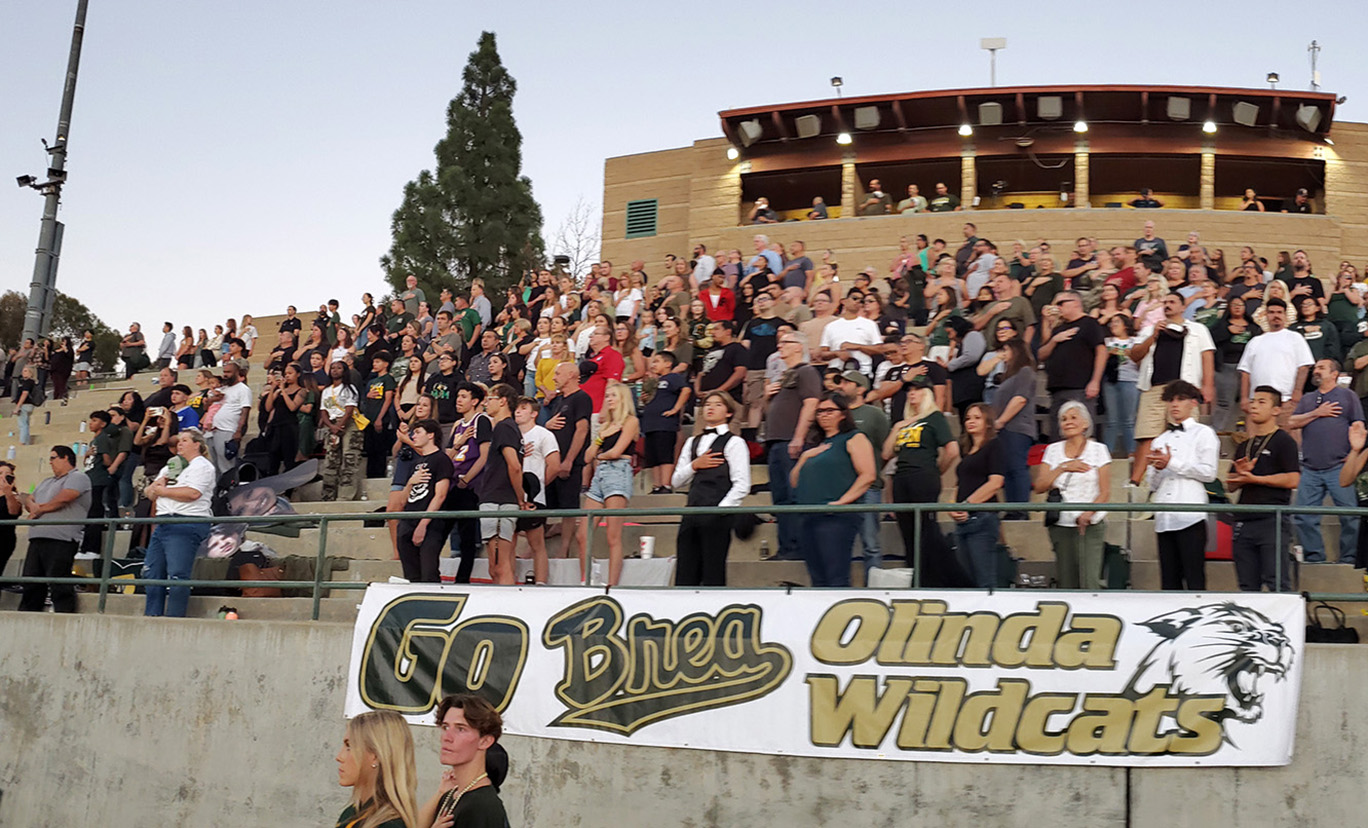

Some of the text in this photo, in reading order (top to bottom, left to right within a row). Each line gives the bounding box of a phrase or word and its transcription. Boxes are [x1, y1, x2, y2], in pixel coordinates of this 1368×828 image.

[542, 597, 793, 736] Brea
[811, 598, 1122, 669] Olinda
[804, 673, 1227, 756] Wildcats
